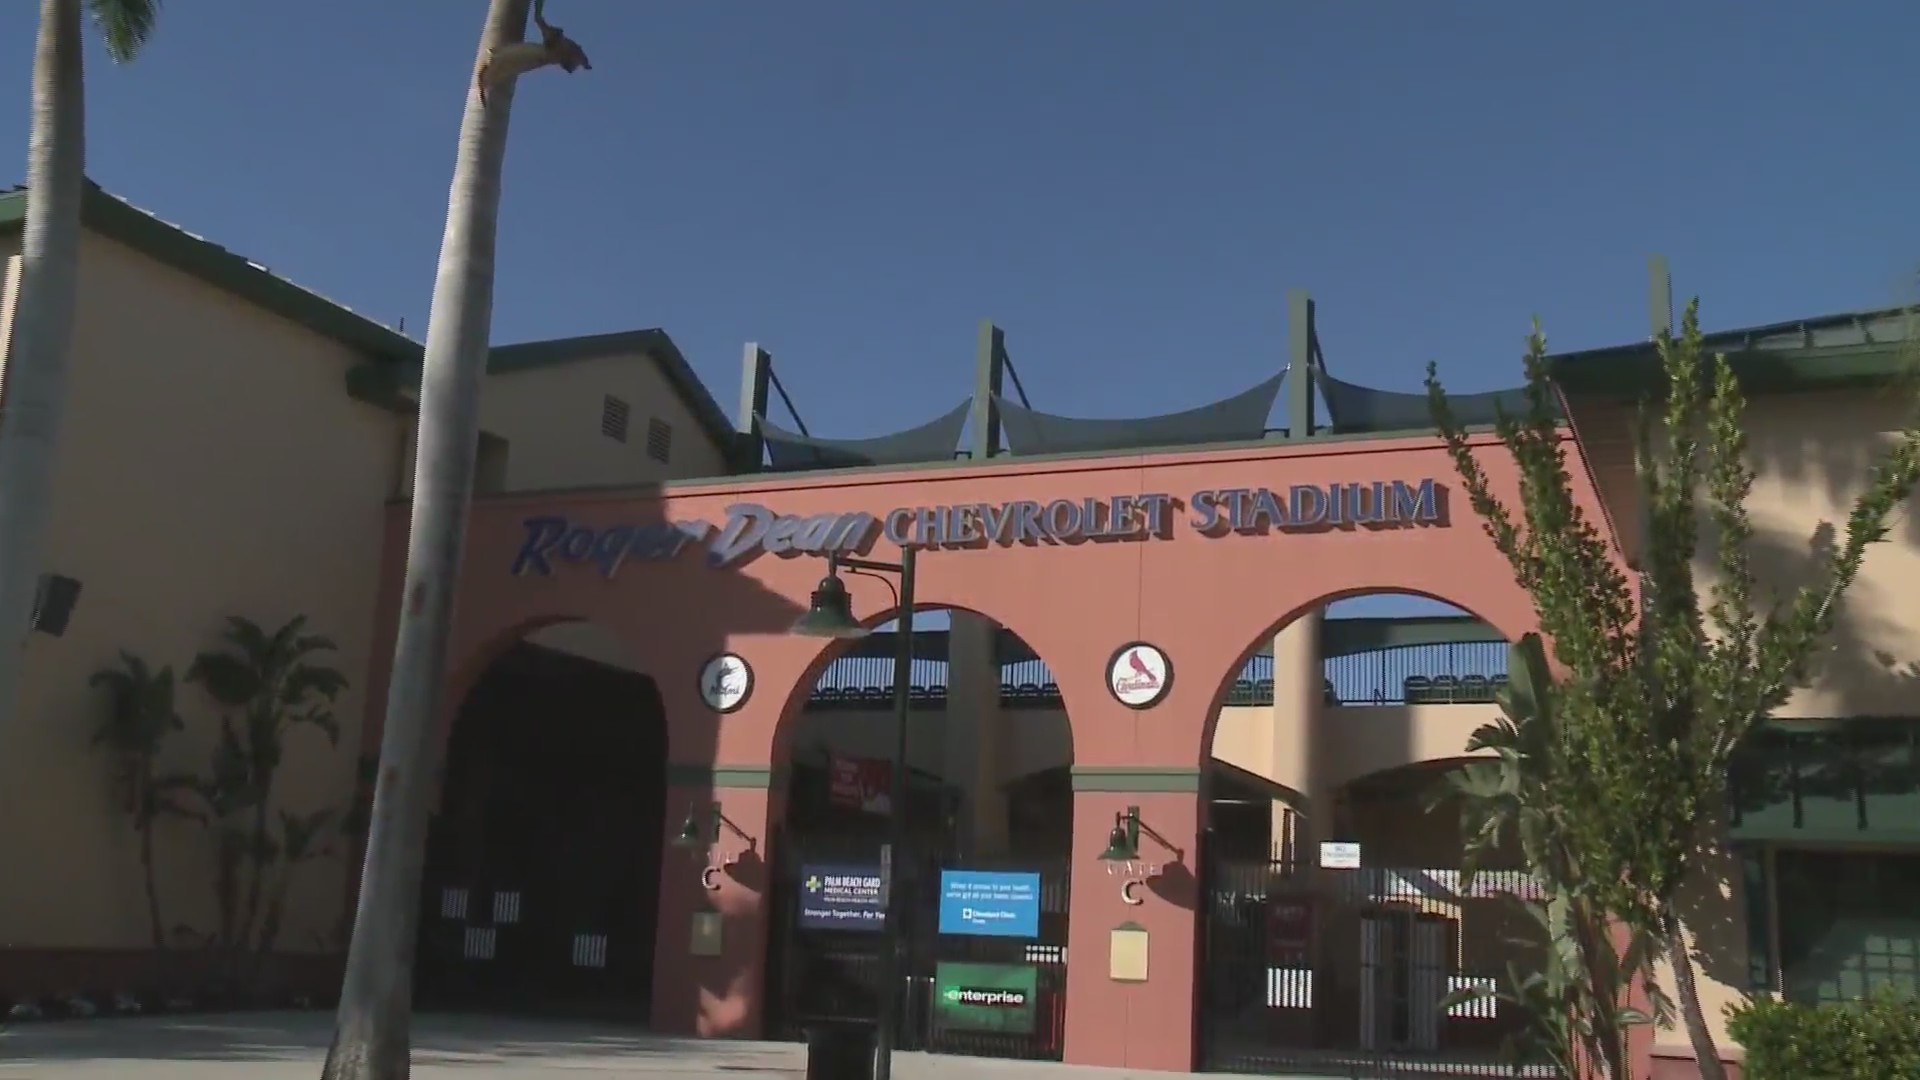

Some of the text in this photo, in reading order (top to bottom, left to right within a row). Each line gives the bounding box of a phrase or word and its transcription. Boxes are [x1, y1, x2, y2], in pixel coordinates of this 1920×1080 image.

[511, 478, 1439, 577] Roger Dean CHEVROLET STADIUM
[701, 865, 721, 891] C
[824, 876, 841, 887] PALM
[842, 876, 862, 888] BEACH
[1121, 879, 1144, 906] C
[804, 908, 832, 918] Stronger
[943, 989, 1024, 1006] enterprise
